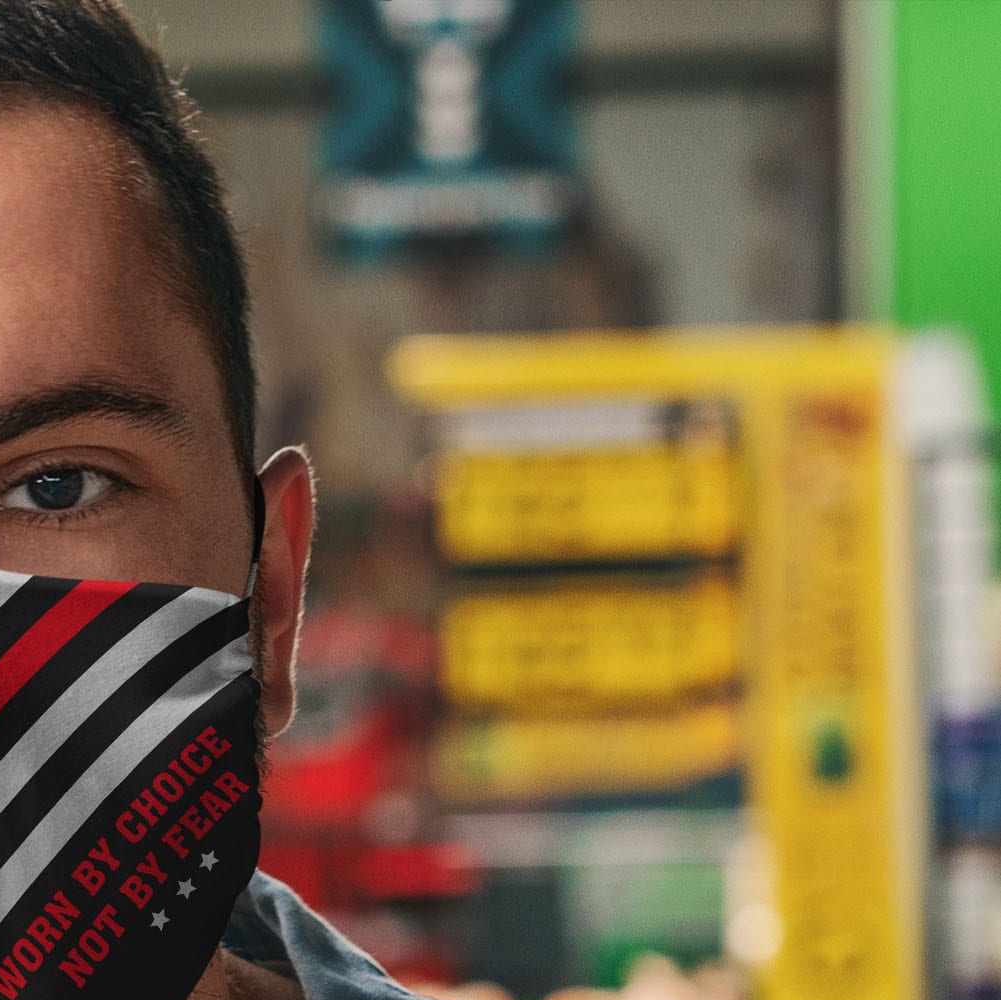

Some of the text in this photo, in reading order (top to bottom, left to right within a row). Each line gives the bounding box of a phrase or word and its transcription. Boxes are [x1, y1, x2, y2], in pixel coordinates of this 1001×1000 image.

[58, 772, 249, 988] NOT BY FEAR
[72, 837, 120, 896] BY
[116, 726, 231, 843] CHOICE
